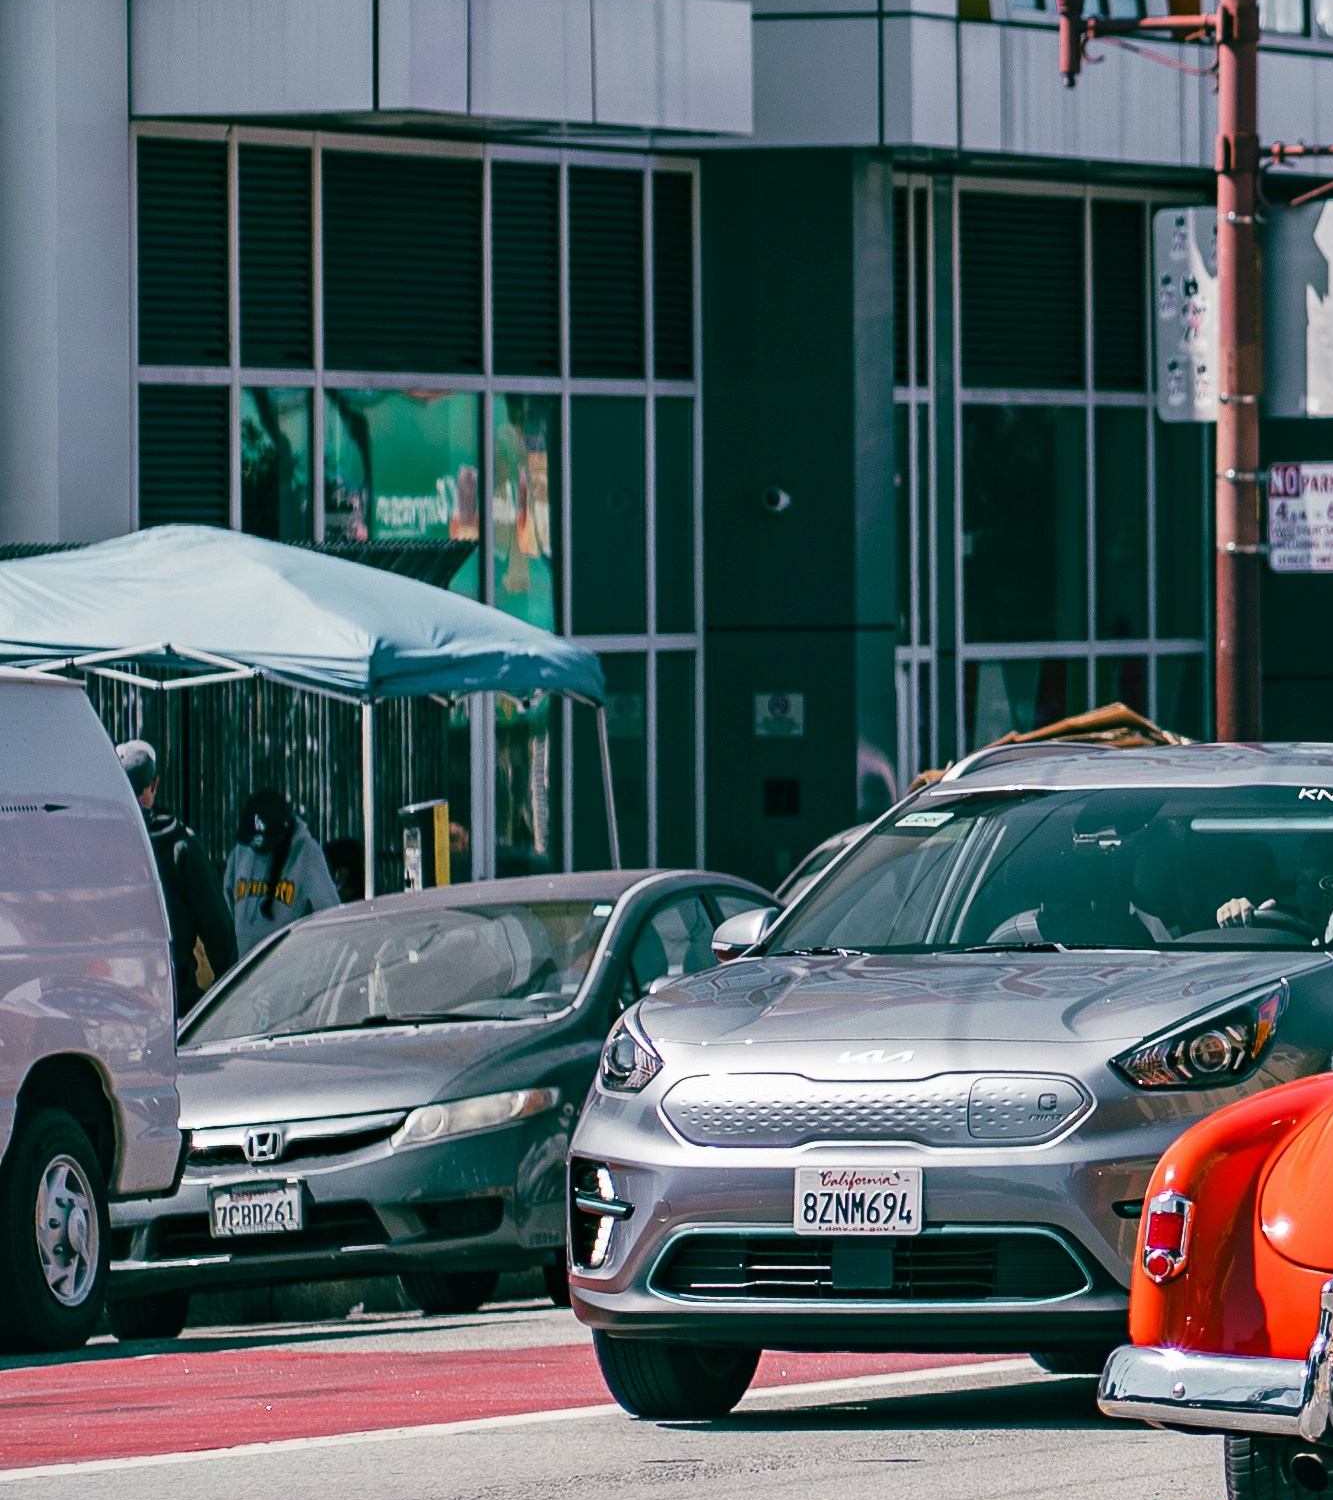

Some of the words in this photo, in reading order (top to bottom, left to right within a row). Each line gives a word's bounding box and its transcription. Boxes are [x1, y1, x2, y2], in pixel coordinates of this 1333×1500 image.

[1271, 466, 1298, 495] NO
[821, 1170, 899, 1191] California
[217, 1200, 295, 1228] 7CBD261
[803, 1192, 913, 1224] 8ZNM694
